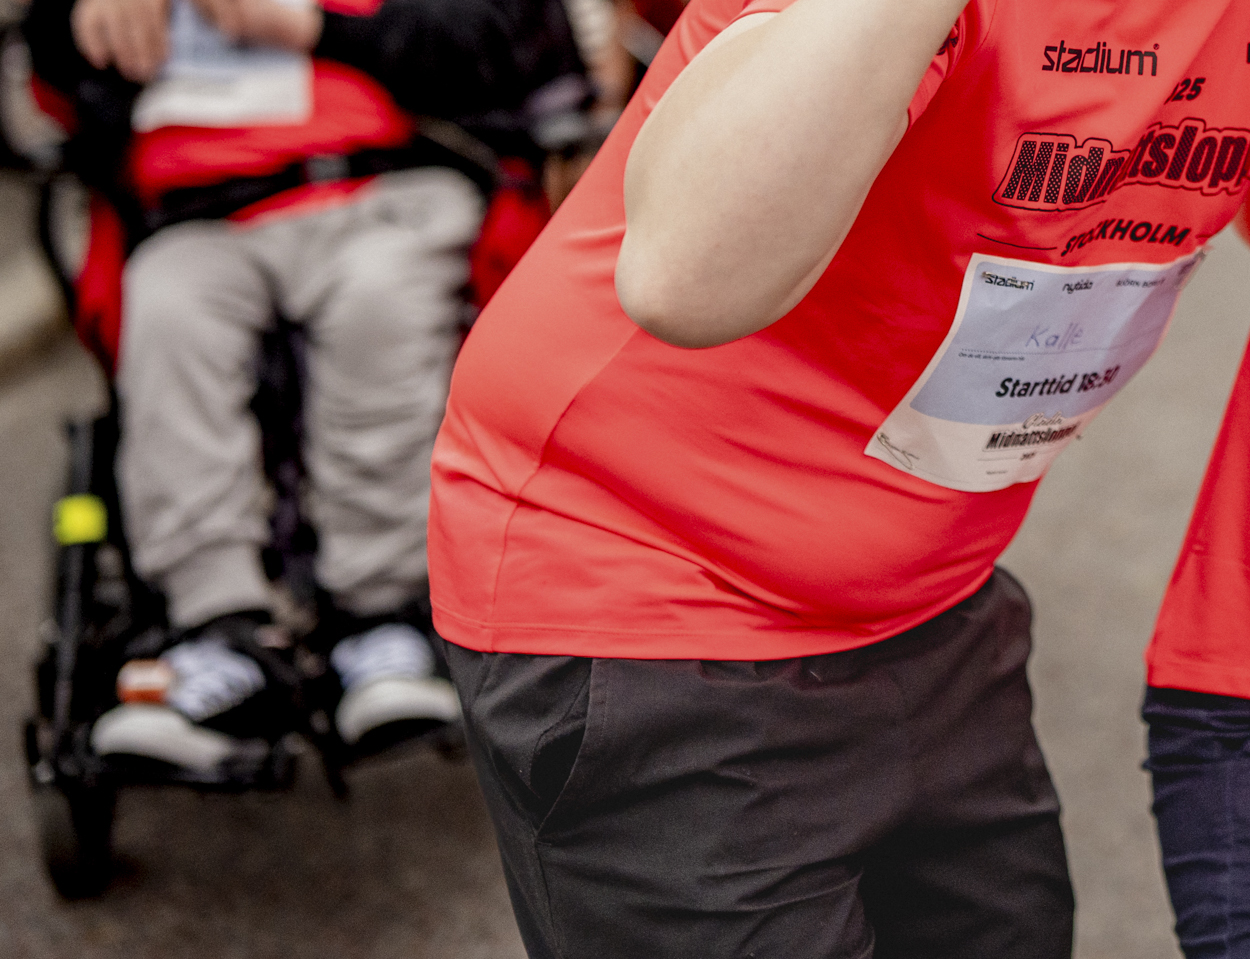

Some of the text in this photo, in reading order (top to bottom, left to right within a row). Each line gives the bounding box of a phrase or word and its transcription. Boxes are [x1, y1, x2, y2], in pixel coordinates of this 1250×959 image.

[1041, 40, 1160, 77] stadium
[1025, 322, 1084, 350] Kalle
[995, 372, 1078, 398] Starttid
